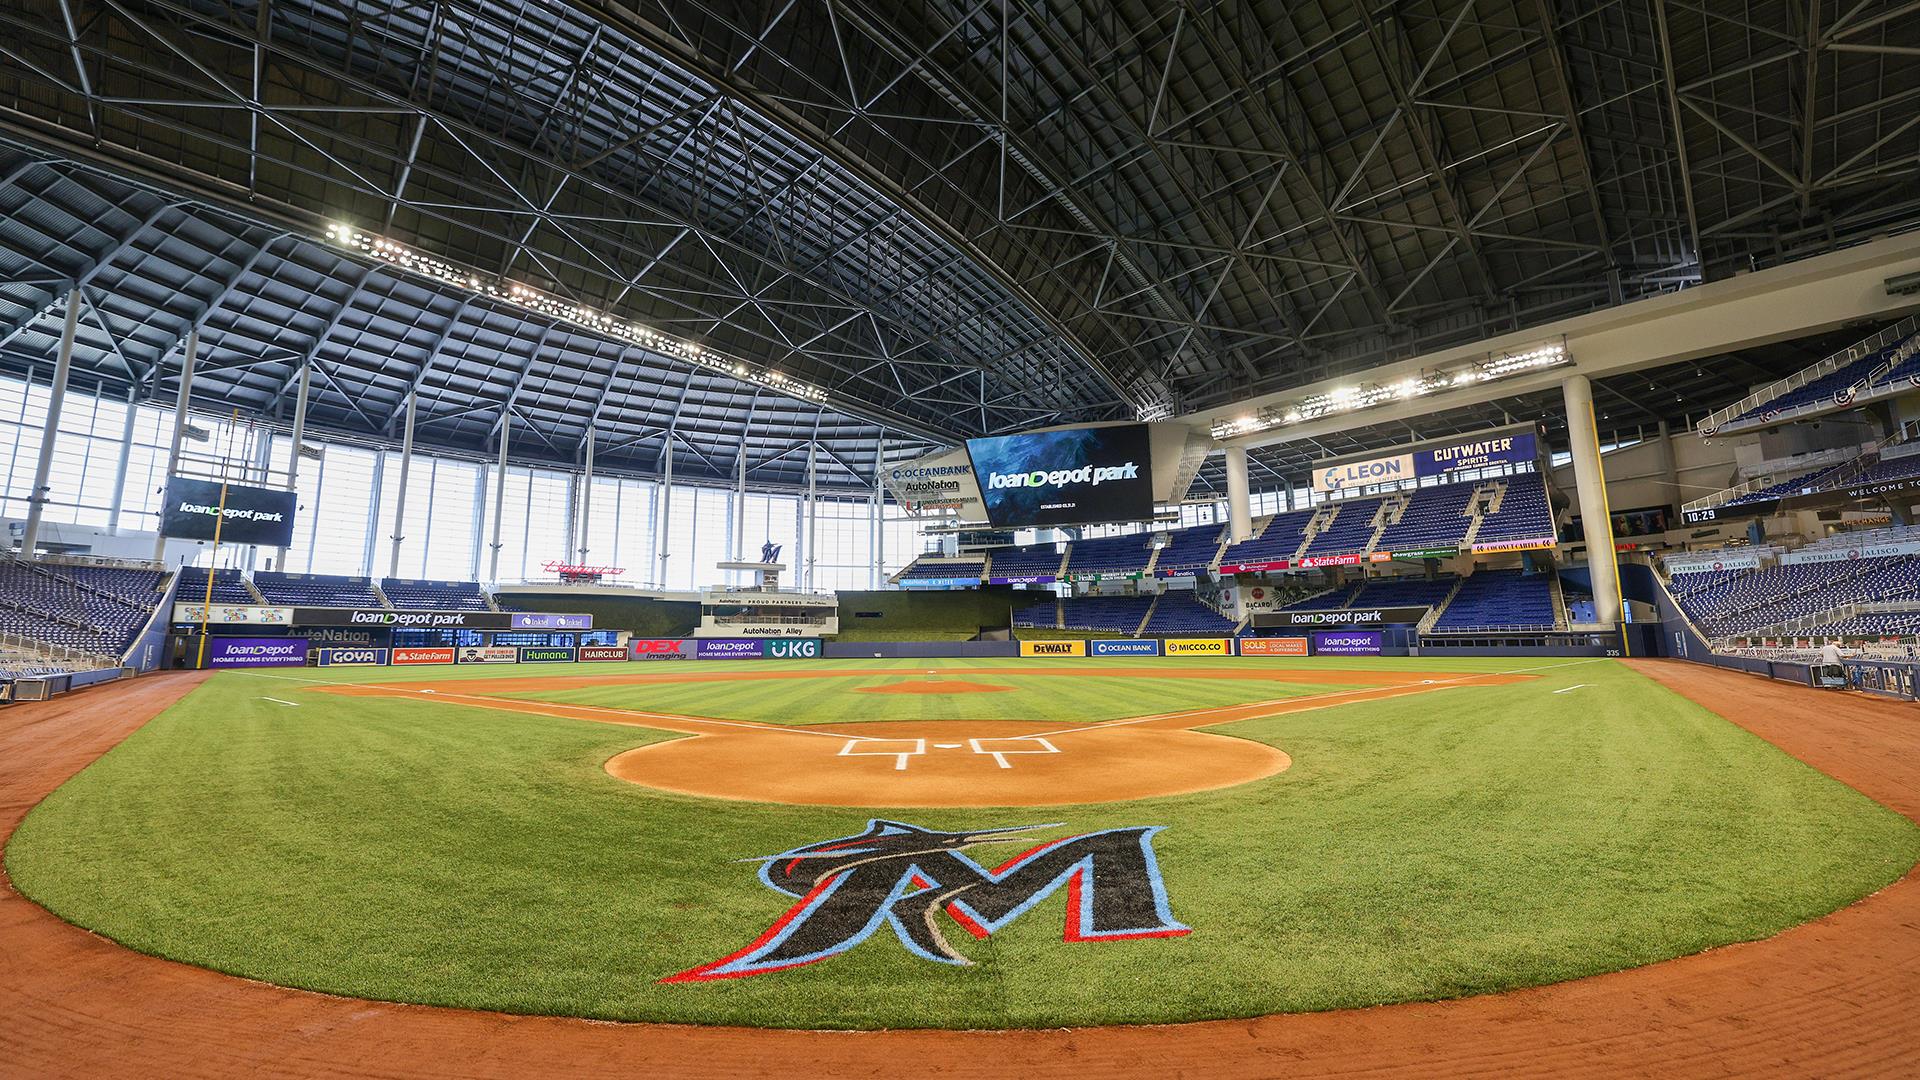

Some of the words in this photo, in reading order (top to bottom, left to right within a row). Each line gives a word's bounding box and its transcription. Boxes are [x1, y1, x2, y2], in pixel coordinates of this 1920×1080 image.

[1433, 437, 1513, 462] CUTWATER
[1457, 455, 1489, 467] SPIRITS
[988, 464, 1093, 489] loanDepot
[1092, 461, 1139, 486] park
[1347, 459, 1401, 481] LEON
[905, 479, 958, 492] AutoNation
[1848, 483, 1904, 497] WELCOME
[252, 508, 283, 522] park
[1687, 509, 1716, 522] 10:29
[1801, 553, 1846, 562] ESTRELLA
[1672, 563, 1712, 572] ESTRELLA
[1724, 560, 1757, 568] JALISCO
[1007, 576, 1038, 584] loanDepot
[351, 610, 433, 626] loanDepot
[432, 613, 465, 626] park
[1291, 611, 1352, 624] loanDepot
[1353, 610, 1381, 624] park
[743, 627, 781, 635] AutoNation
[786, 627, 803, 635] Alley
[636, 640, 684, 653] DEX
[706, 641, 756, 651] loanDepot
[1244, 641, 1267, 650] SOLIS
[1324, 636, 1372, 646] loanDepot
[225, 644, 297, 655] loanDepot
[1134, 643, 1152, 651] BANK
[1179, 643, 1221, 651] MICCO.CO
[333, 651, 375, 662] GOYA
[526, 651, 569, 660] Humana
[584, 650, 624, 658] HAIRCLUB
[1606, 649, 1620, 657] 335
